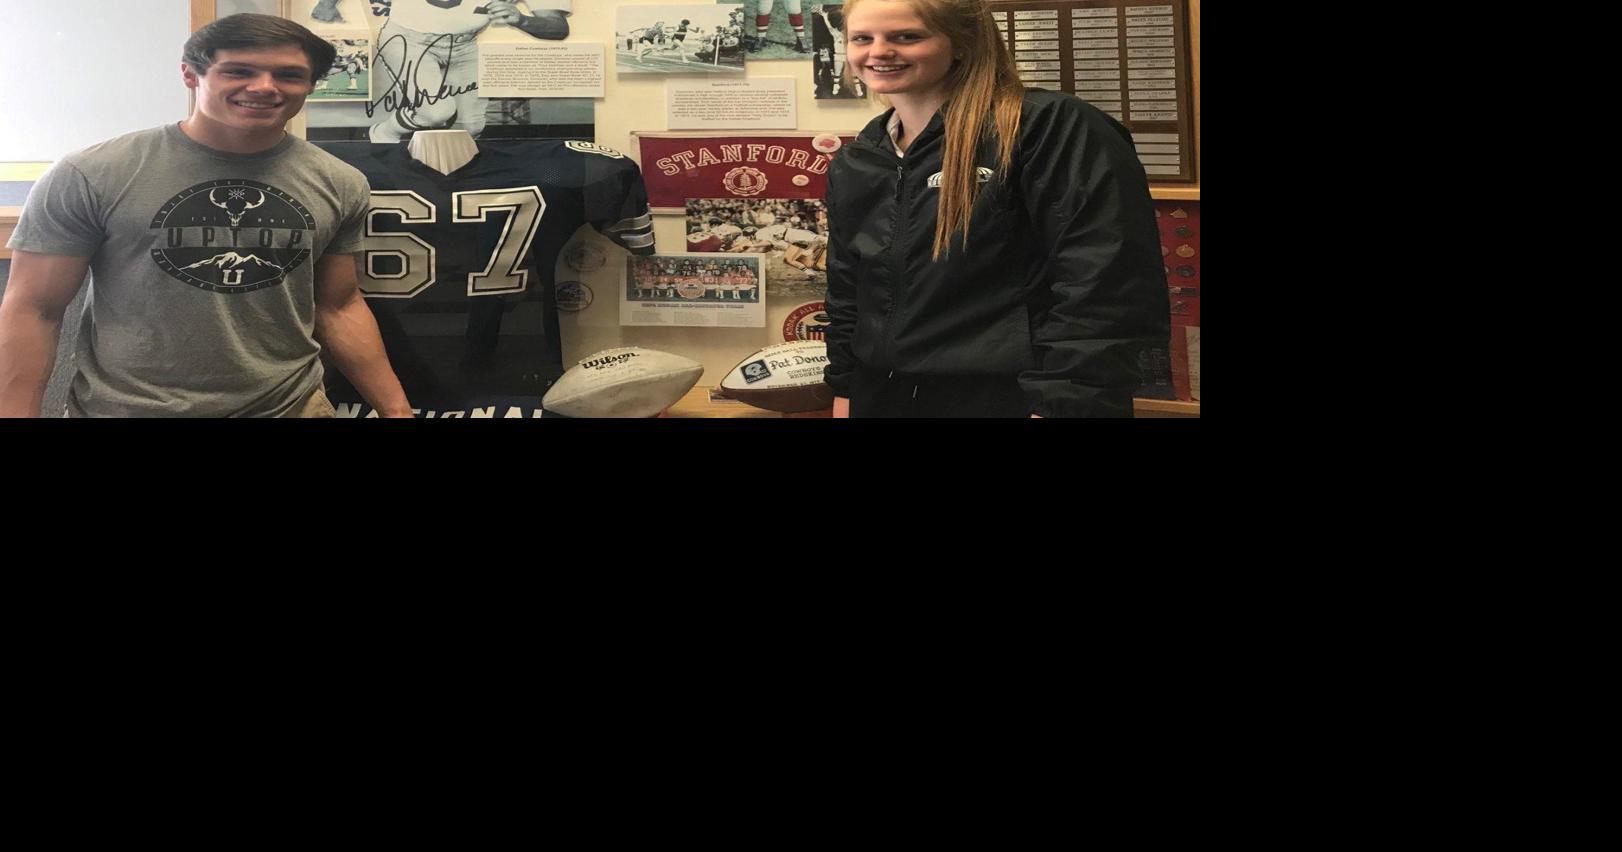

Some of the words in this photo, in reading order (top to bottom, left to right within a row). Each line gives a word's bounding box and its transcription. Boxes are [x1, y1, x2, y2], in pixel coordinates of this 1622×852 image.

[656, 144, 828, 176] STANFORD
[358, 185, 546, 299] 67
[222, 269, 244, 285] U
[582, 352, 636, 369] Wilson
[769, 358, 793, 371] Pat
[336, 402, 543, 417] NIONA
